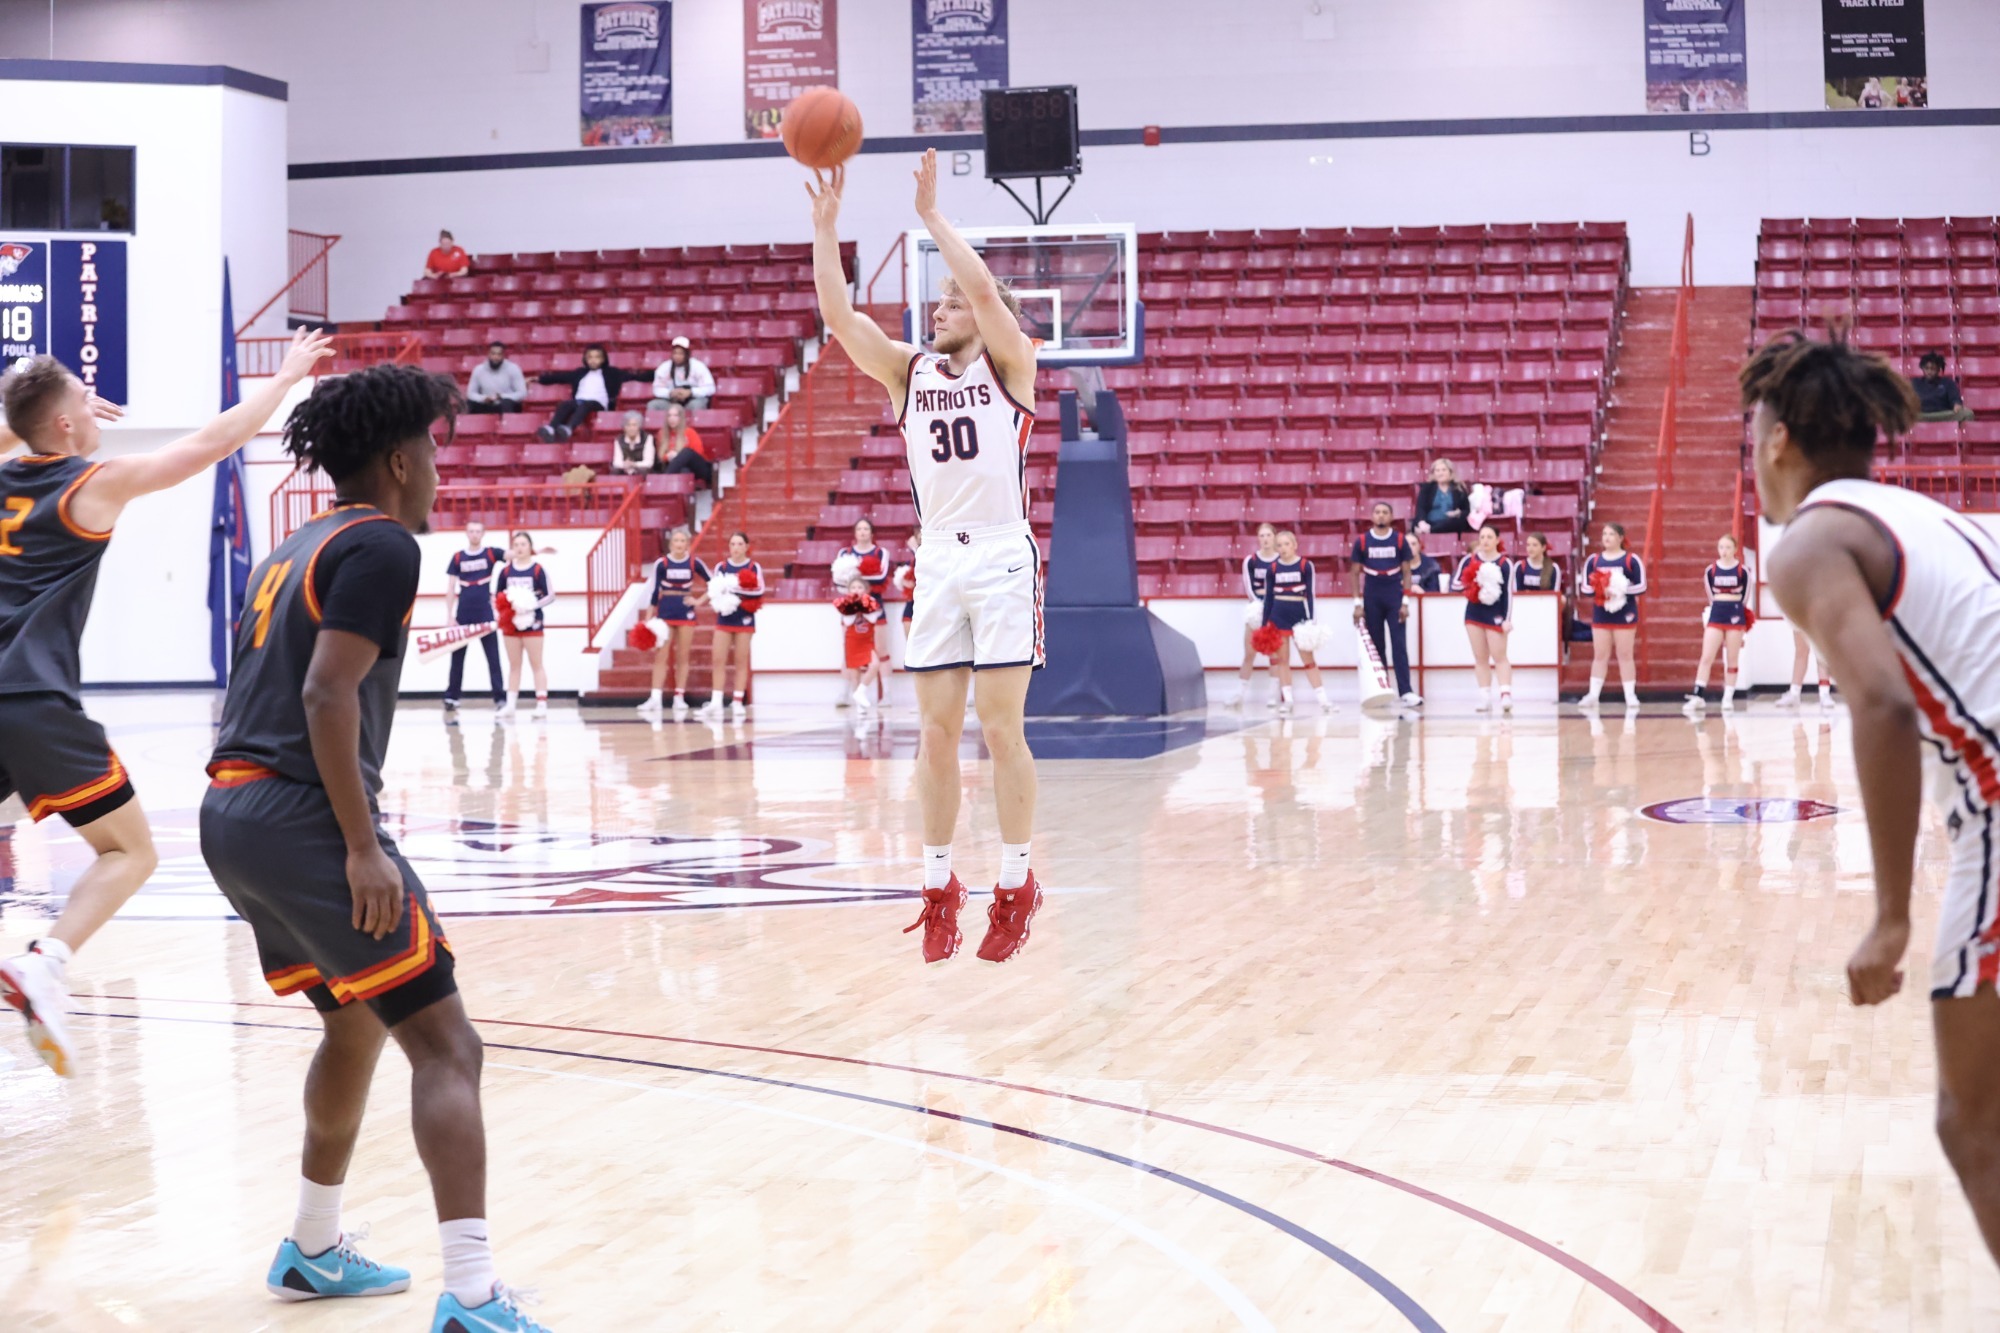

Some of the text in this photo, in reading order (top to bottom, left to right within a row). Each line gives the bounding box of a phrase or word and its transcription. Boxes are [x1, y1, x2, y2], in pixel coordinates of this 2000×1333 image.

[596, 11, 657, 37] PATRIOTS
[760, 1, 821, 28] PATRIOTS
[3, 306, 32, 341] 18
[3, 344, 36, 356] FOULS
[915, 384, 991, 412] PATRIOTS
[930, 416, 979, 463] 30
[956, 532, 970, 545] UC
[252, 560, 293, 648] 4
